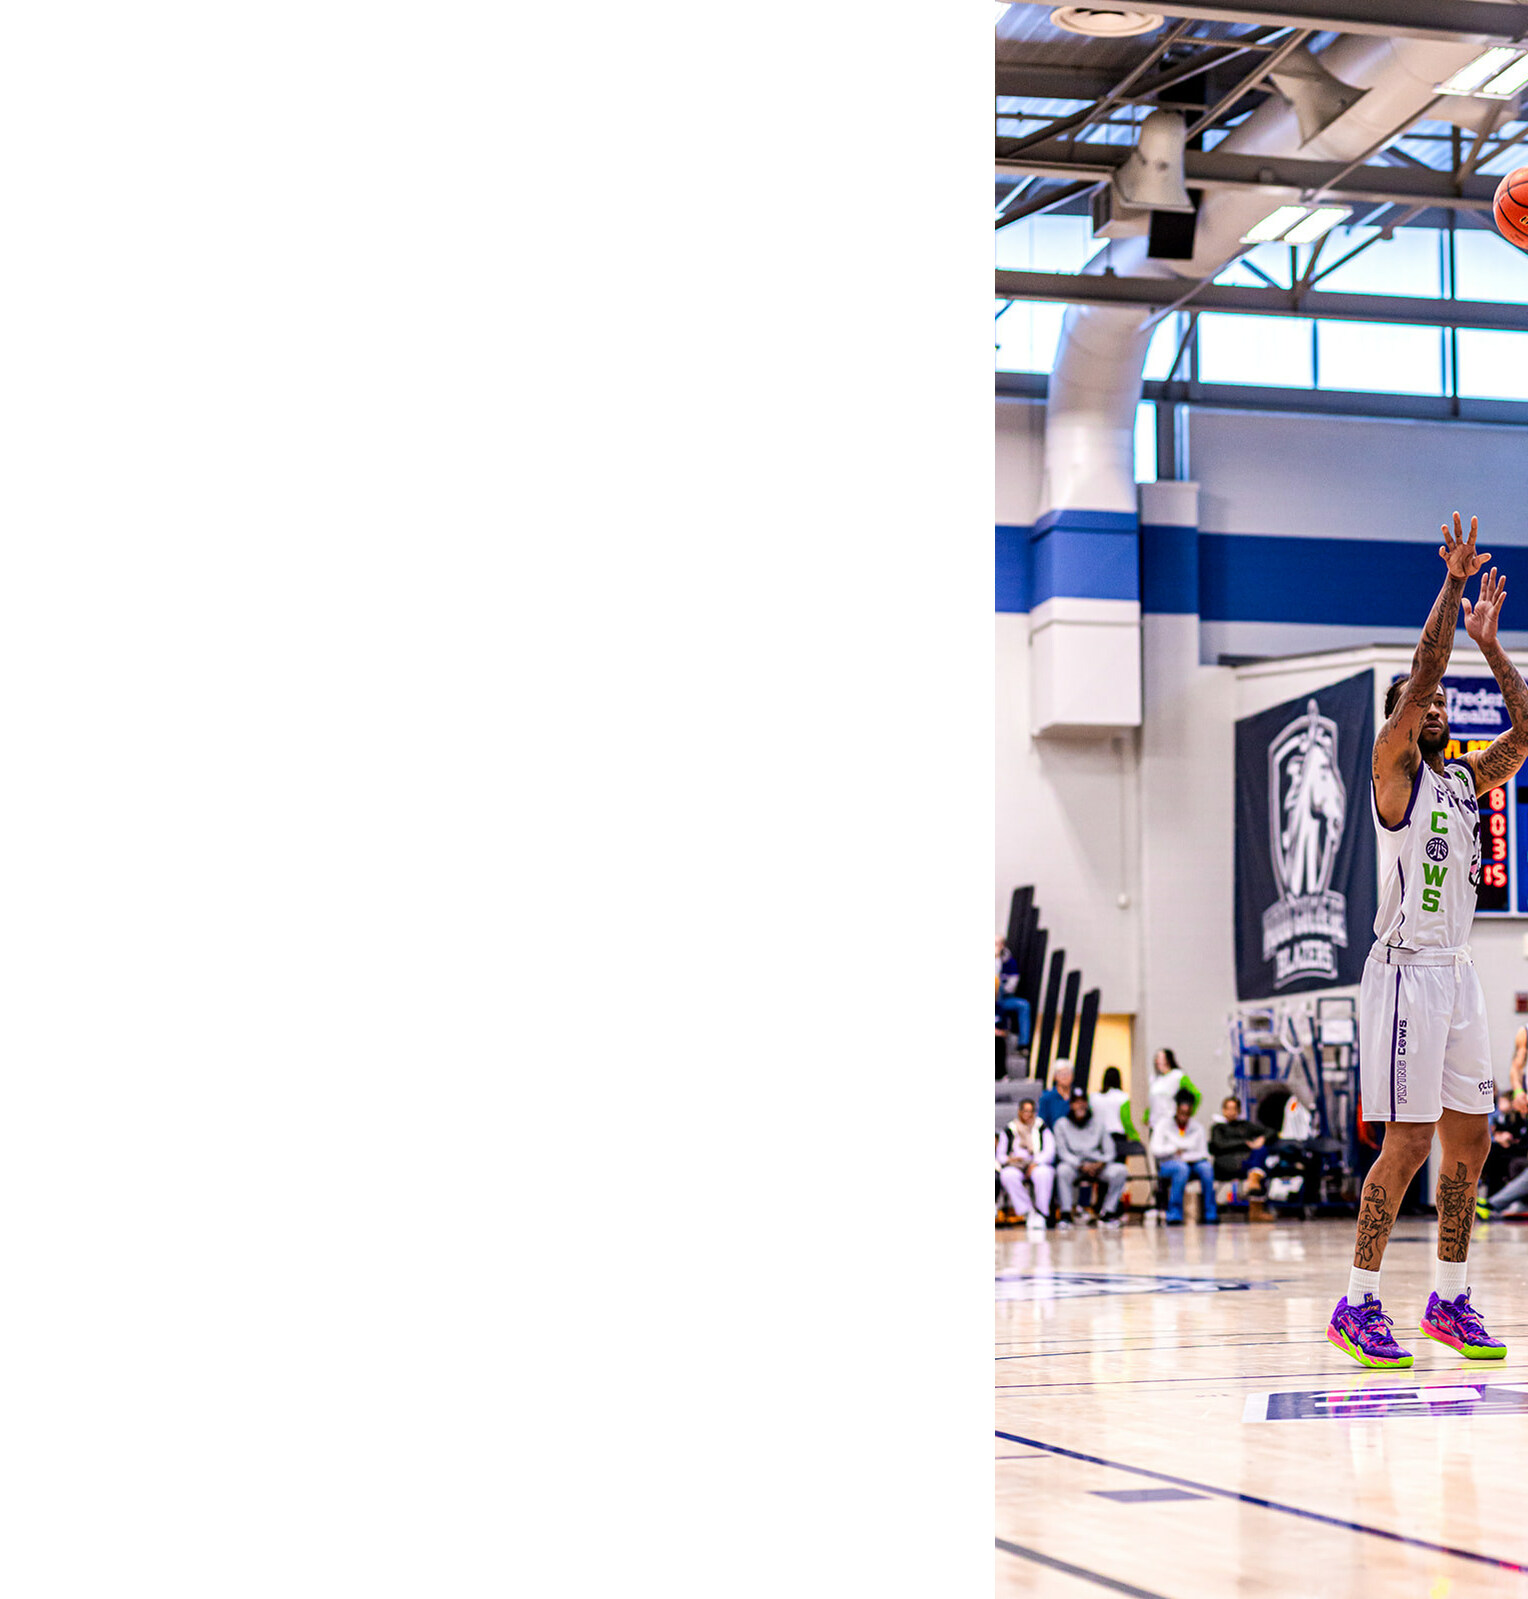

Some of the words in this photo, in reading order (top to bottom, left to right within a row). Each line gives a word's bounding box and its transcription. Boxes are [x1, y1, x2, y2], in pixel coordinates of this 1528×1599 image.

[1447, 707, 1502, 725] Health
[1489, 787, 1506, 812] 8
[1490, 813, 1506, 837] 0
[1492, 837, 1507, 861] 3
[1484, 862, 1507, 887] 15
[1397, 1060, 1408, 1104] FLYING
